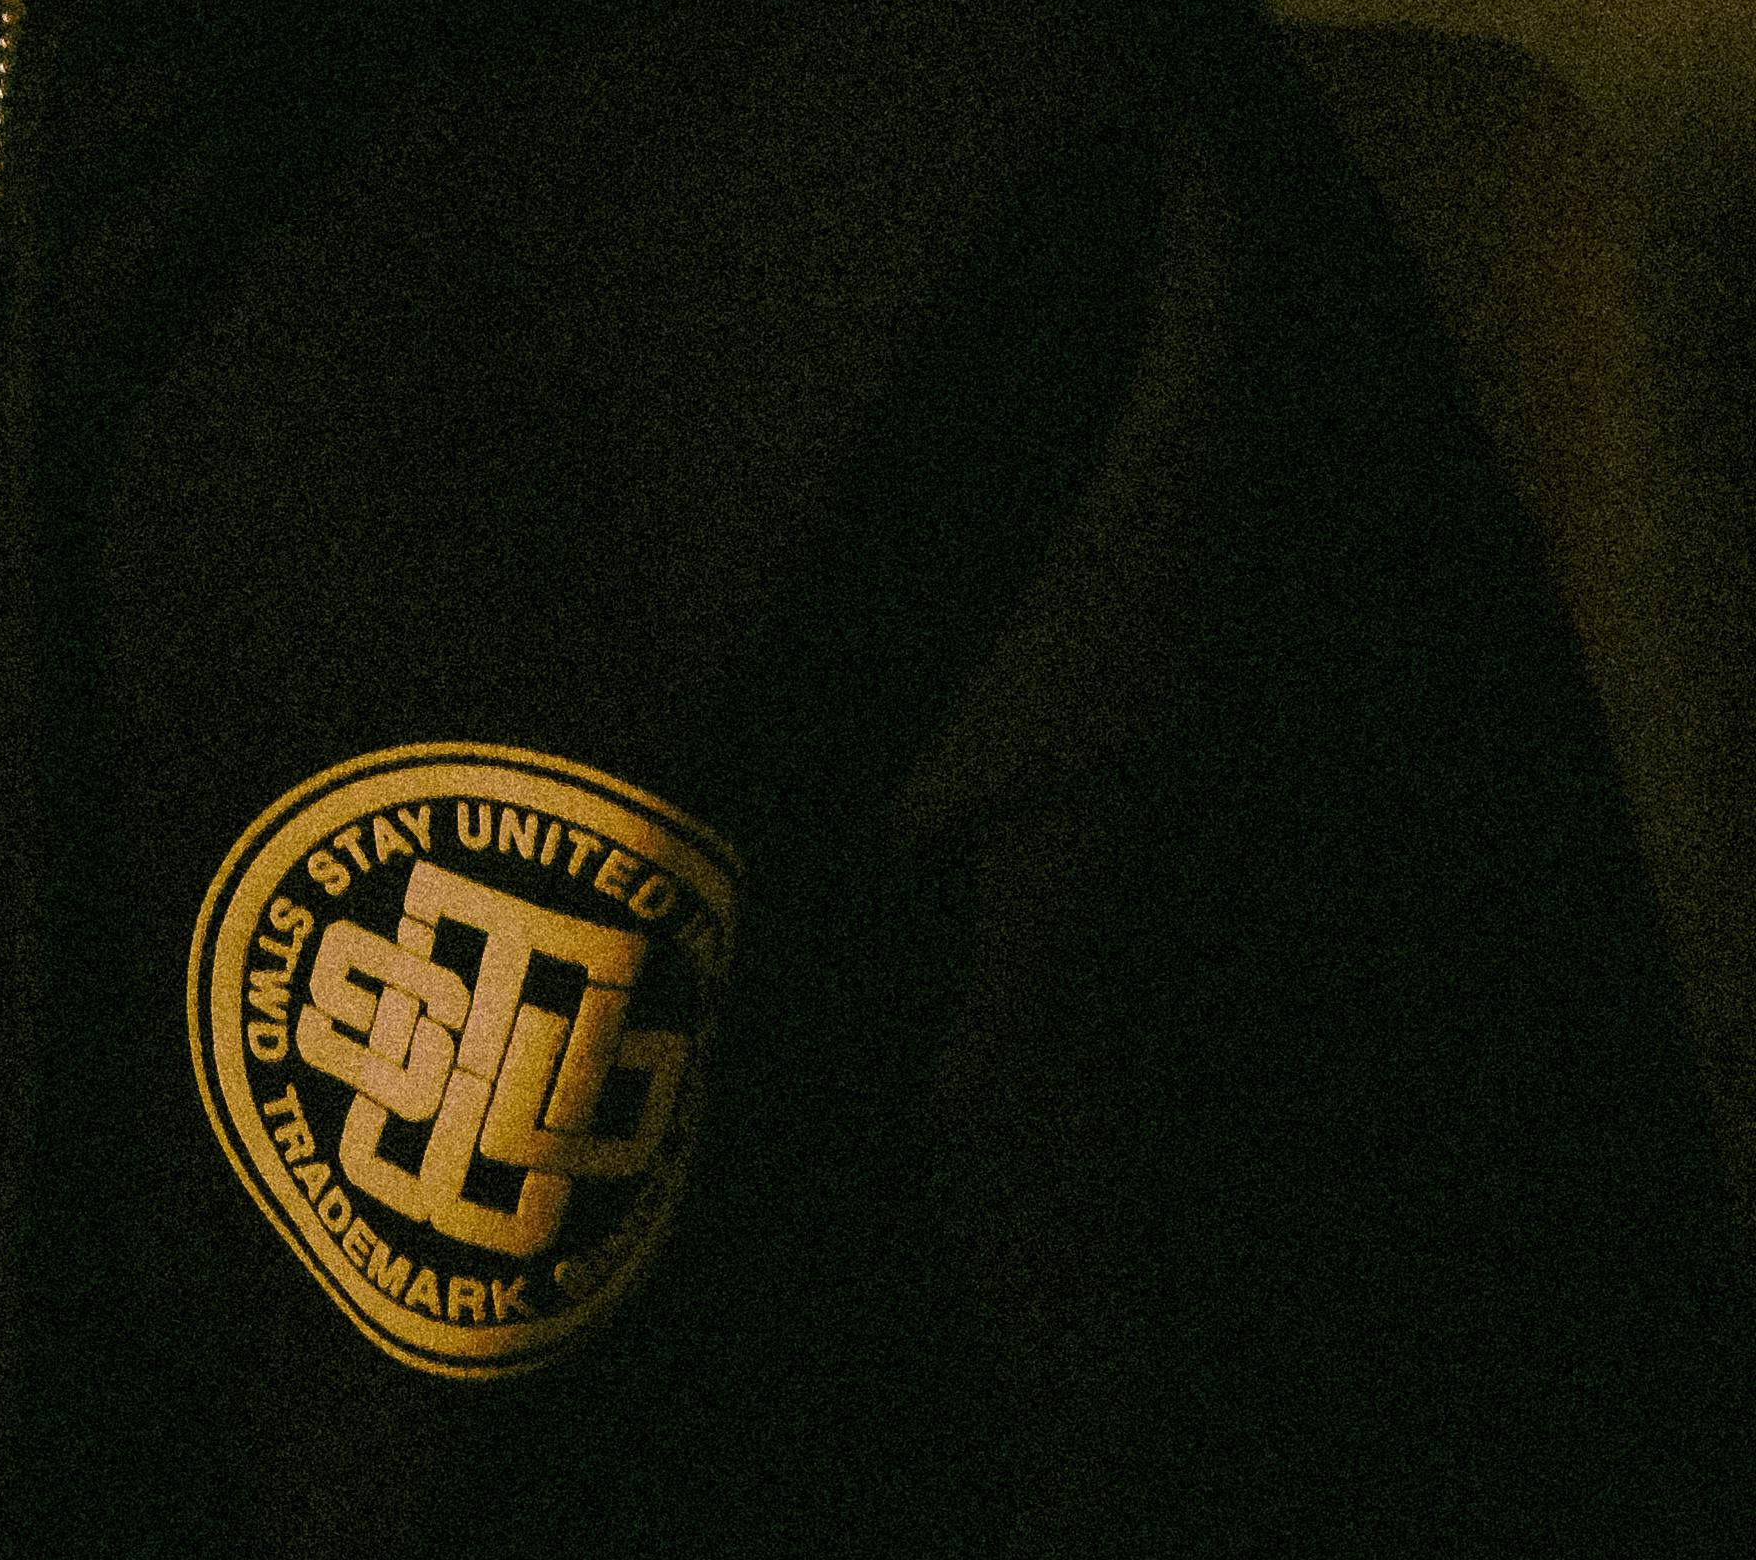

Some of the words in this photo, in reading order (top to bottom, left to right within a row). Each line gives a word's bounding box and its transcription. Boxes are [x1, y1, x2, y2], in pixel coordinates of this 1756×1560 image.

[306, 803, 432, 897] STAY
[455, 800, 678, 921] UNITED
[246, 895, 316, 1064] STWD
[262, 1081, 534, 1323] TRADEMARK
